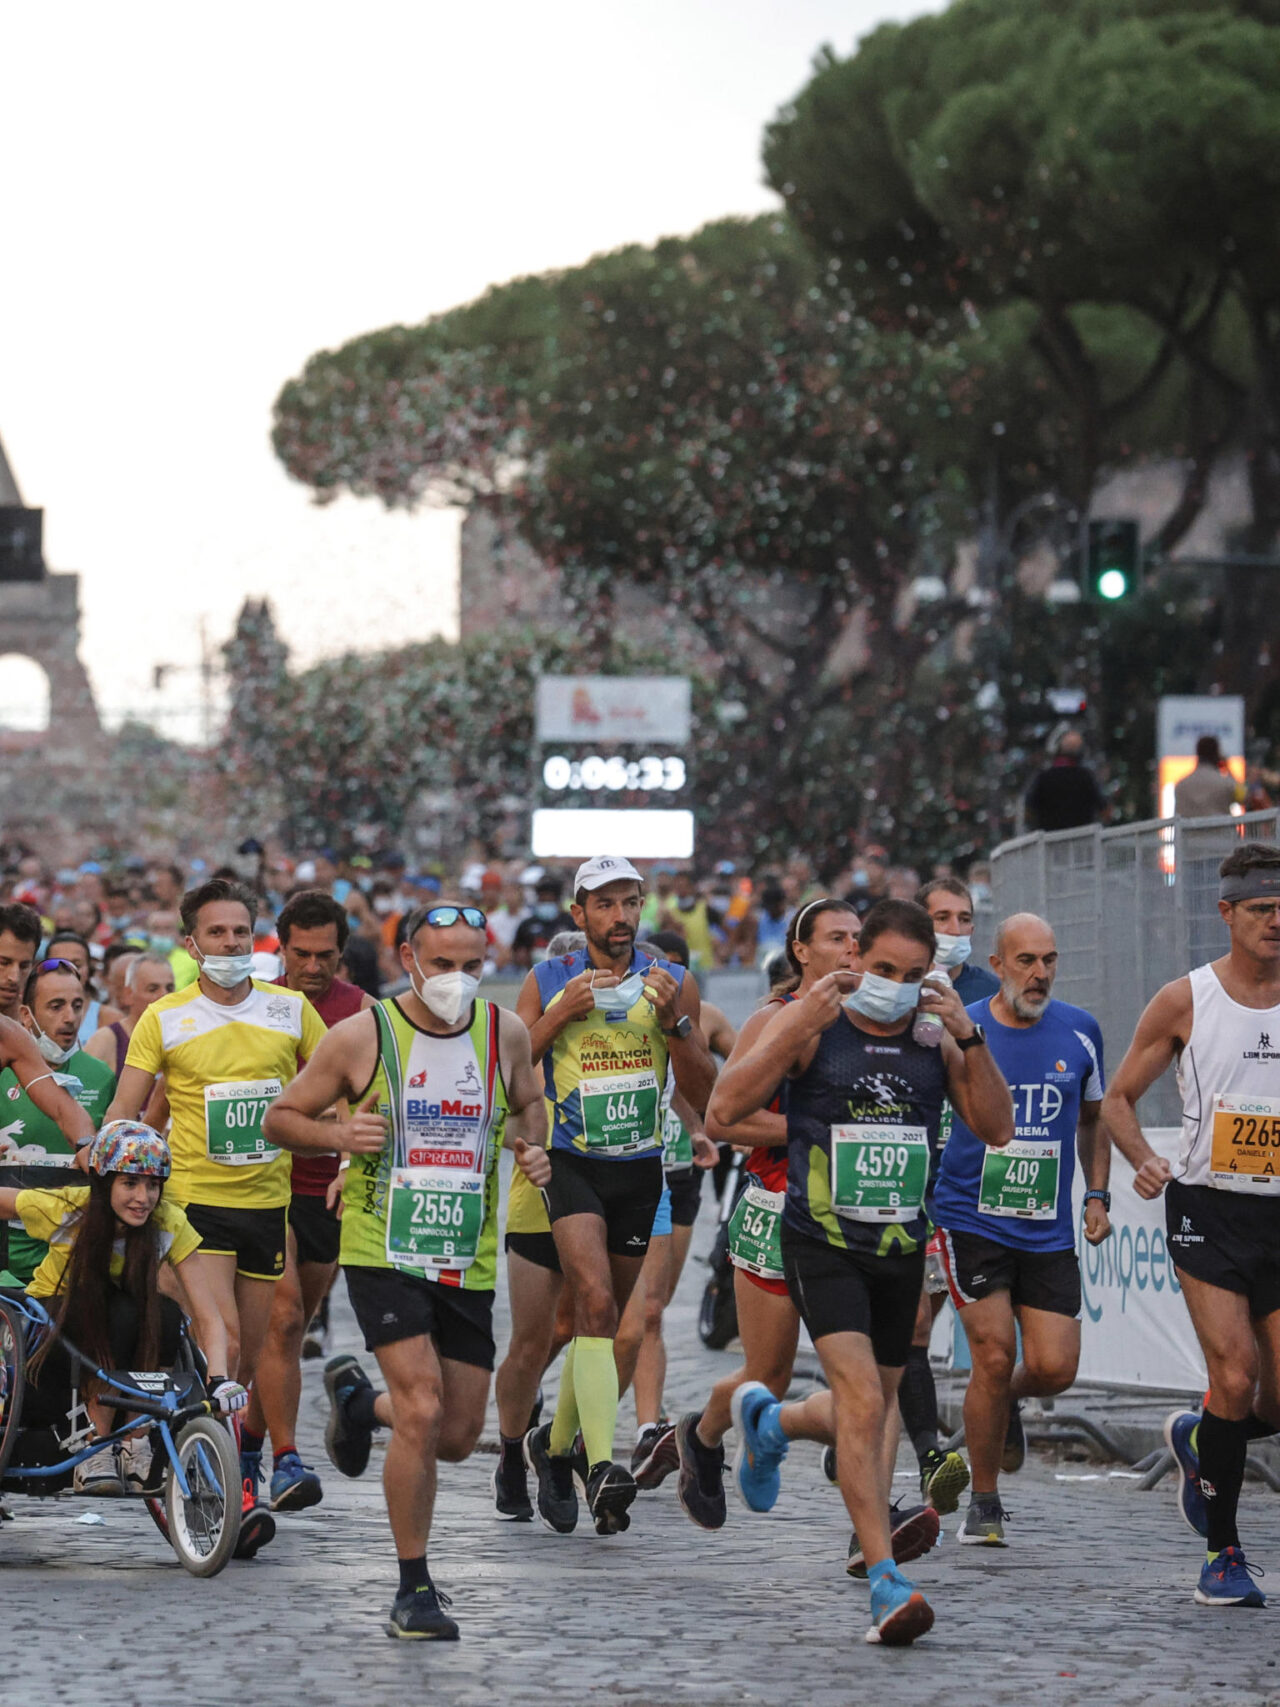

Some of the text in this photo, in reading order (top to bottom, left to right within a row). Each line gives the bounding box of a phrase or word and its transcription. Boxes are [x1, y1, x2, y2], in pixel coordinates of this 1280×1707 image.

[581, 1049, 652, 1061] MARATHON
[582, 1058, 653, 1072] MISILMERI
[264, 1085, 280, 1095] 2021
[407, 1100, 483, 1119] BigMat
[607, 1093, 639, 1121] 664
[1240, 1103, 1272, 1113] acea
[631, 1130, 640, 1142] B
[862, 1132, 923, 1141] acea 2021
[1232, 1117, 1280, 1147] 2265
[225, 1139, 266, 1153] 9 B
[1237, 1148, 1266, 1157] DANIELE
[855, 1146, 909, 1177] 4599
[1229, 1158, 1275, 1174] 4 A
[1005, 1160, 1040, 1185] 409
[858, 1180, 897, 1188] CRISTIANO
[1002, 1185, 1033, 1194] GIUSEPPE
[855, 1190, 900, 1206] 7 B
[998, 1193, 1037, 1209] 1 B
[410, 1192, 465, 1226] 2556
[742, 1205, 776, 1240] 561
[408, 1238, 456, 1255] 4 B
[756, 1252, 767, 1266] B
